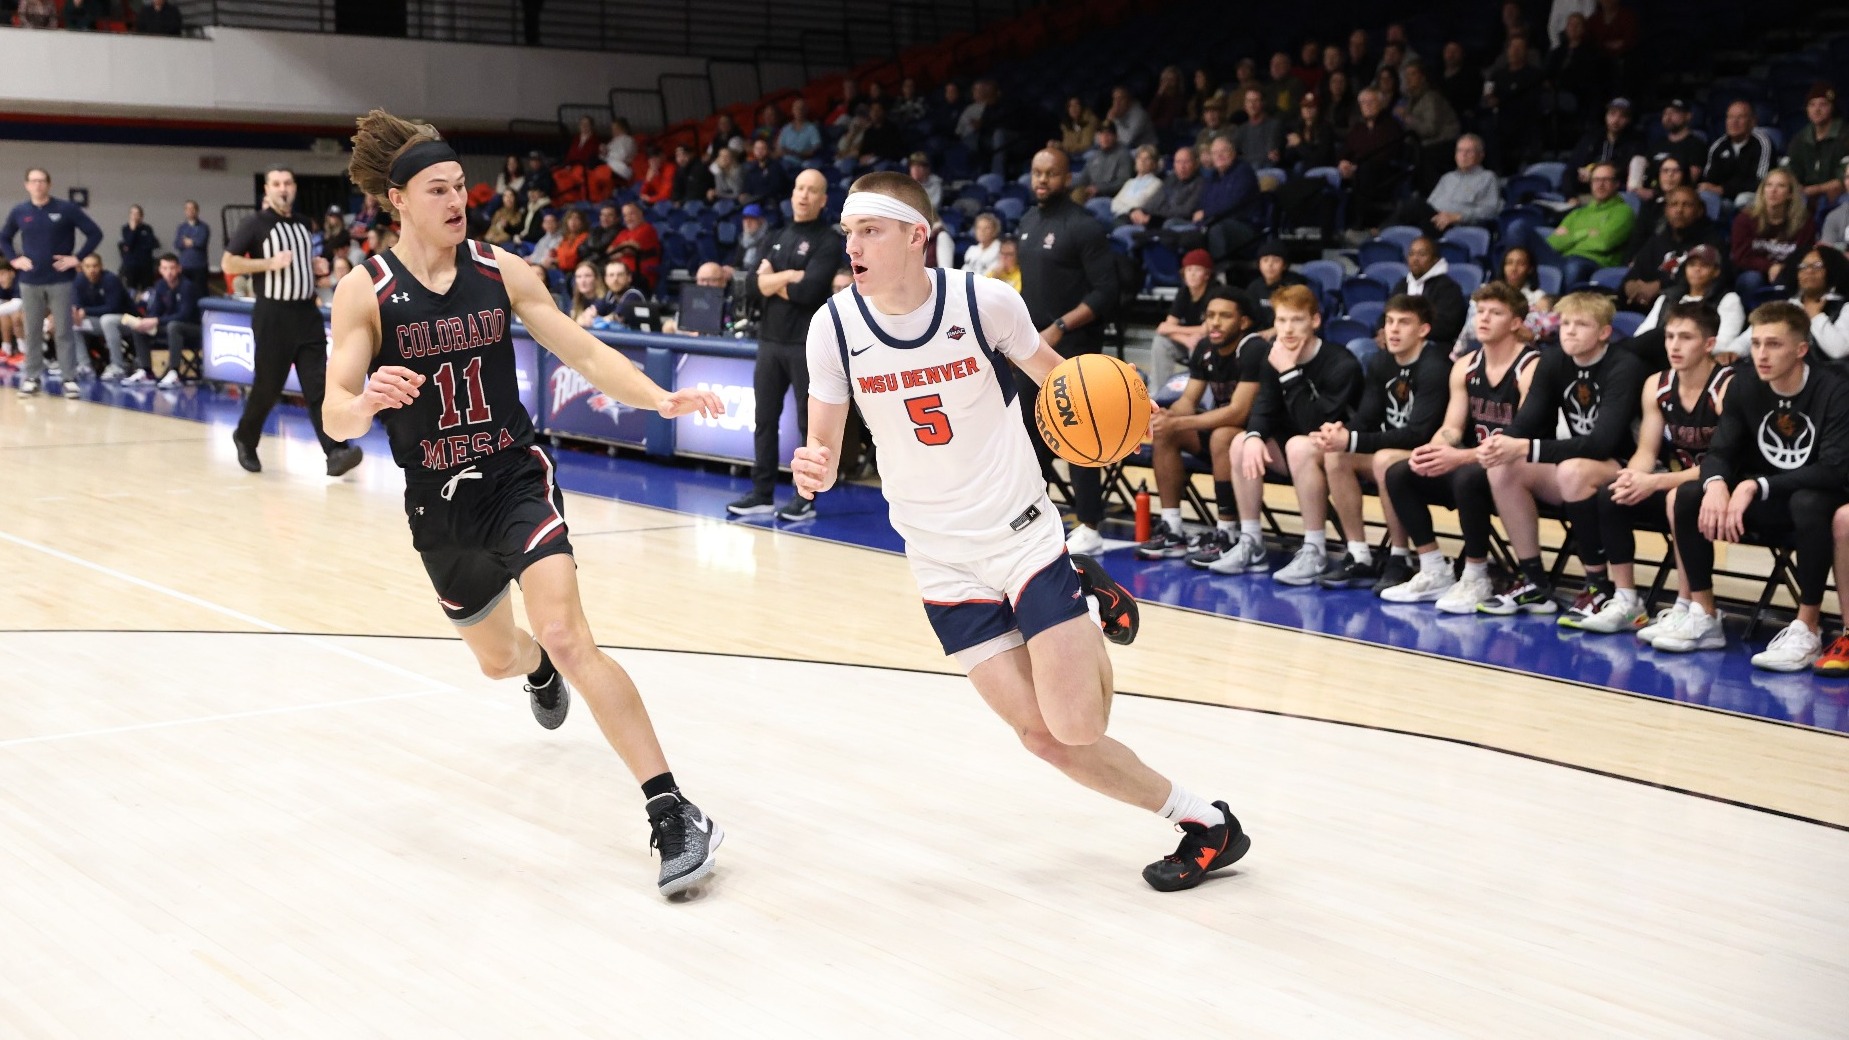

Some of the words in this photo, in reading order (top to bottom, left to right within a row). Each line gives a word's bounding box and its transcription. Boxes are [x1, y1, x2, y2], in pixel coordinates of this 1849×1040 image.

[396, 308, 506, 359] COLORADO
[433, 356, 492, 430] 11
[857, 373, 899, 394] MSU
[900, 356, 981, 389] DENVER
[694, 382, 757, 433] NCA
[904, 393, 954, 446] 5
[1053, 374, 1079, 428] NCAA
[420, 428, 515, 471] MESA
